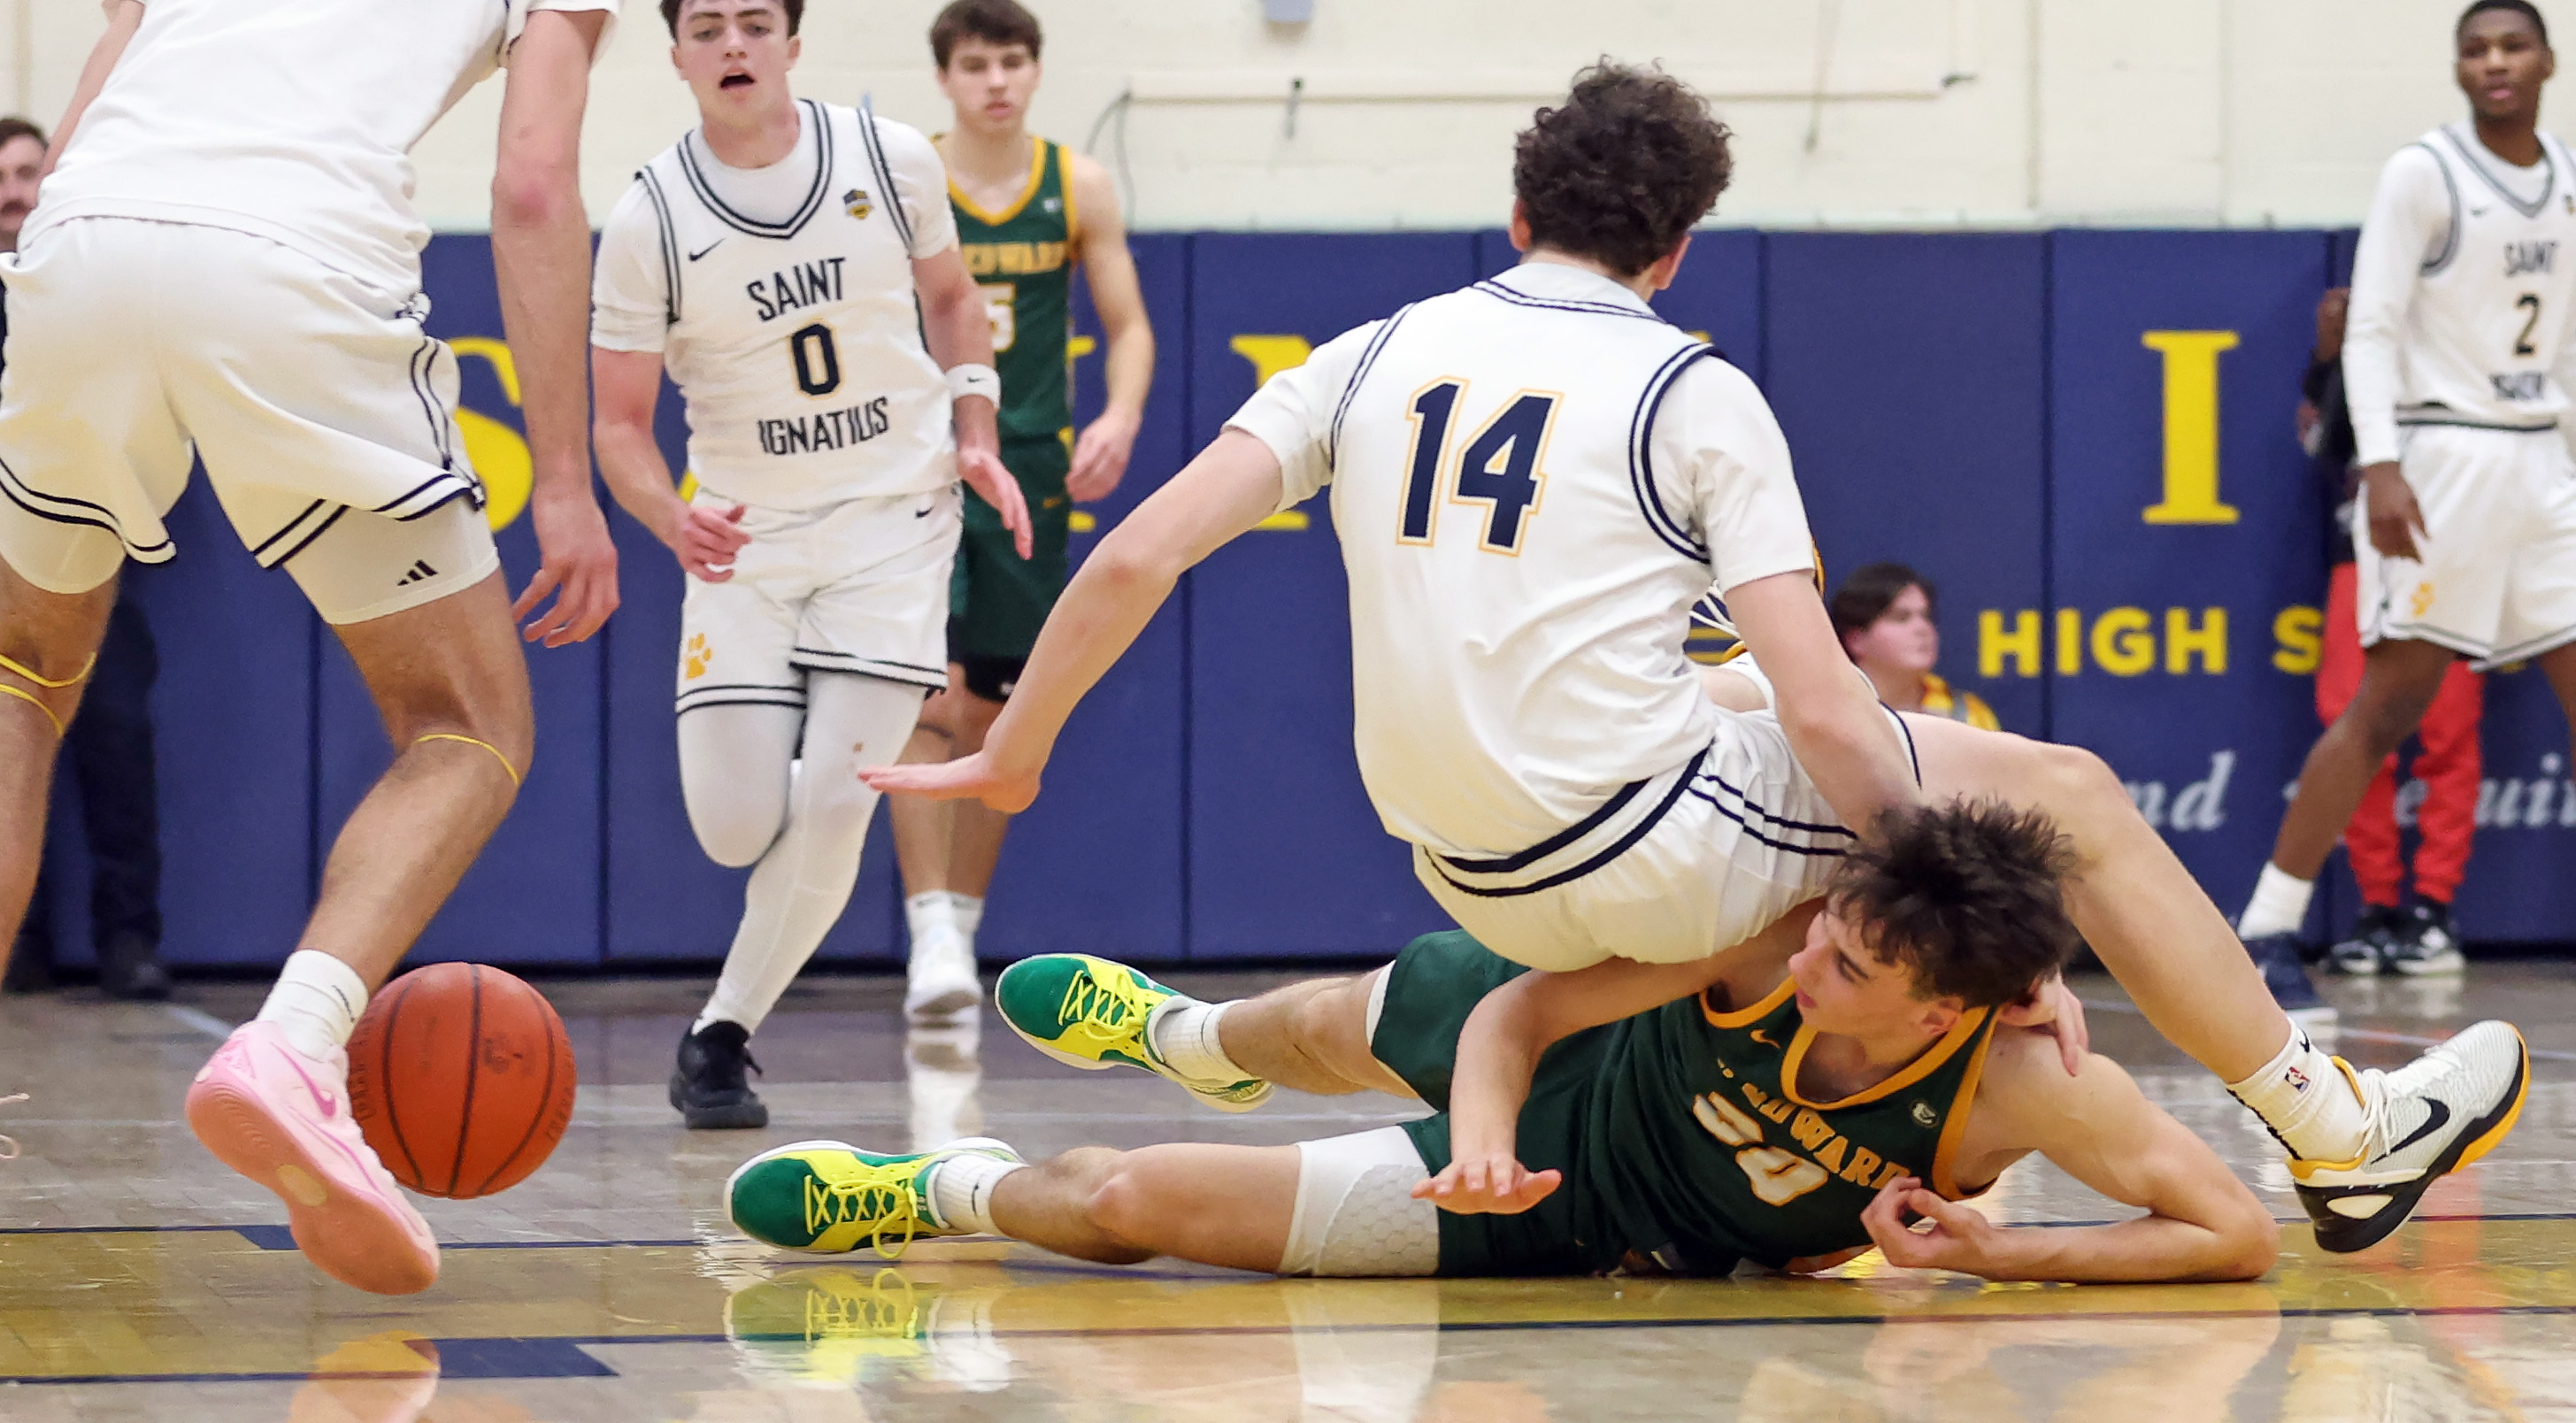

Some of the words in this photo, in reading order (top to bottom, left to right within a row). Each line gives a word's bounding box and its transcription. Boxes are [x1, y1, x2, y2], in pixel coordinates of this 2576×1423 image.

[747, 257, 846, 322] SAINT
[2513, 292, 2541, 357] 2
[787, 319, 845, 400] 0
[757, 396, 888, 455] IGNATIUS
[1396, 375, 1565, 558] 14
[1978, 606, 2227, 677] HIGH
